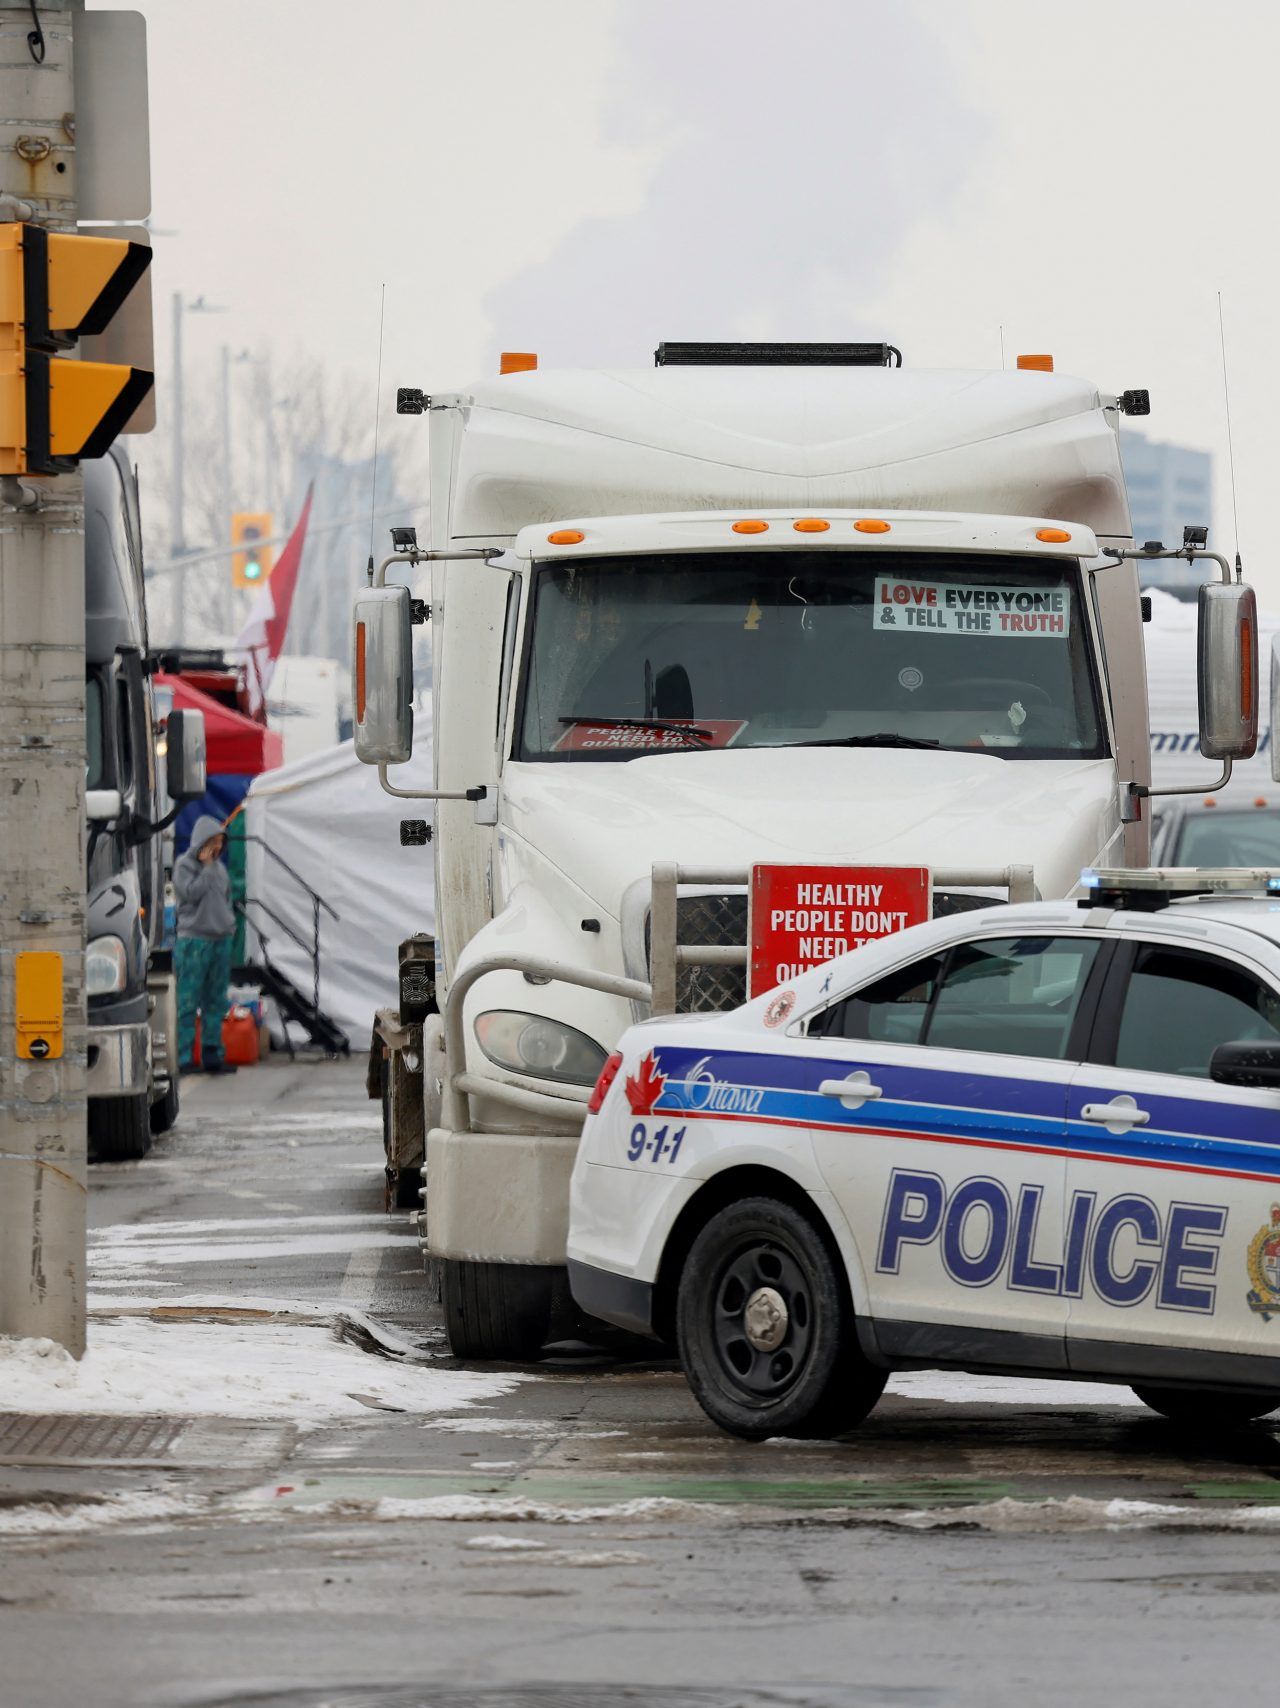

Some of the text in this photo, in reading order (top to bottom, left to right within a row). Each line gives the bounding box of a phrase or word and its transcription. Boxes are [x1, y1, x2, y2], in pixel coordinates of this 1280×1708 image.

[881, 583, 1064, 612] LOVE EVERYONE
[880, 606, 1063, 632] & TELL THE TRUTH
[586, 728, 658, 736] PEOPLE
[607, 734, 655, 742] NEED
[797, 883, 883, 906] HEALTHY
[771, 910, 908, 933] PEOPLE DON'T
[799, 937, 848, 959] NEED
[684, 1056, 765, 1112] Ottawa
[627, 1122, 687, 1164] 9-1-1
[875, 1167, 1229, 1315] POLICE
